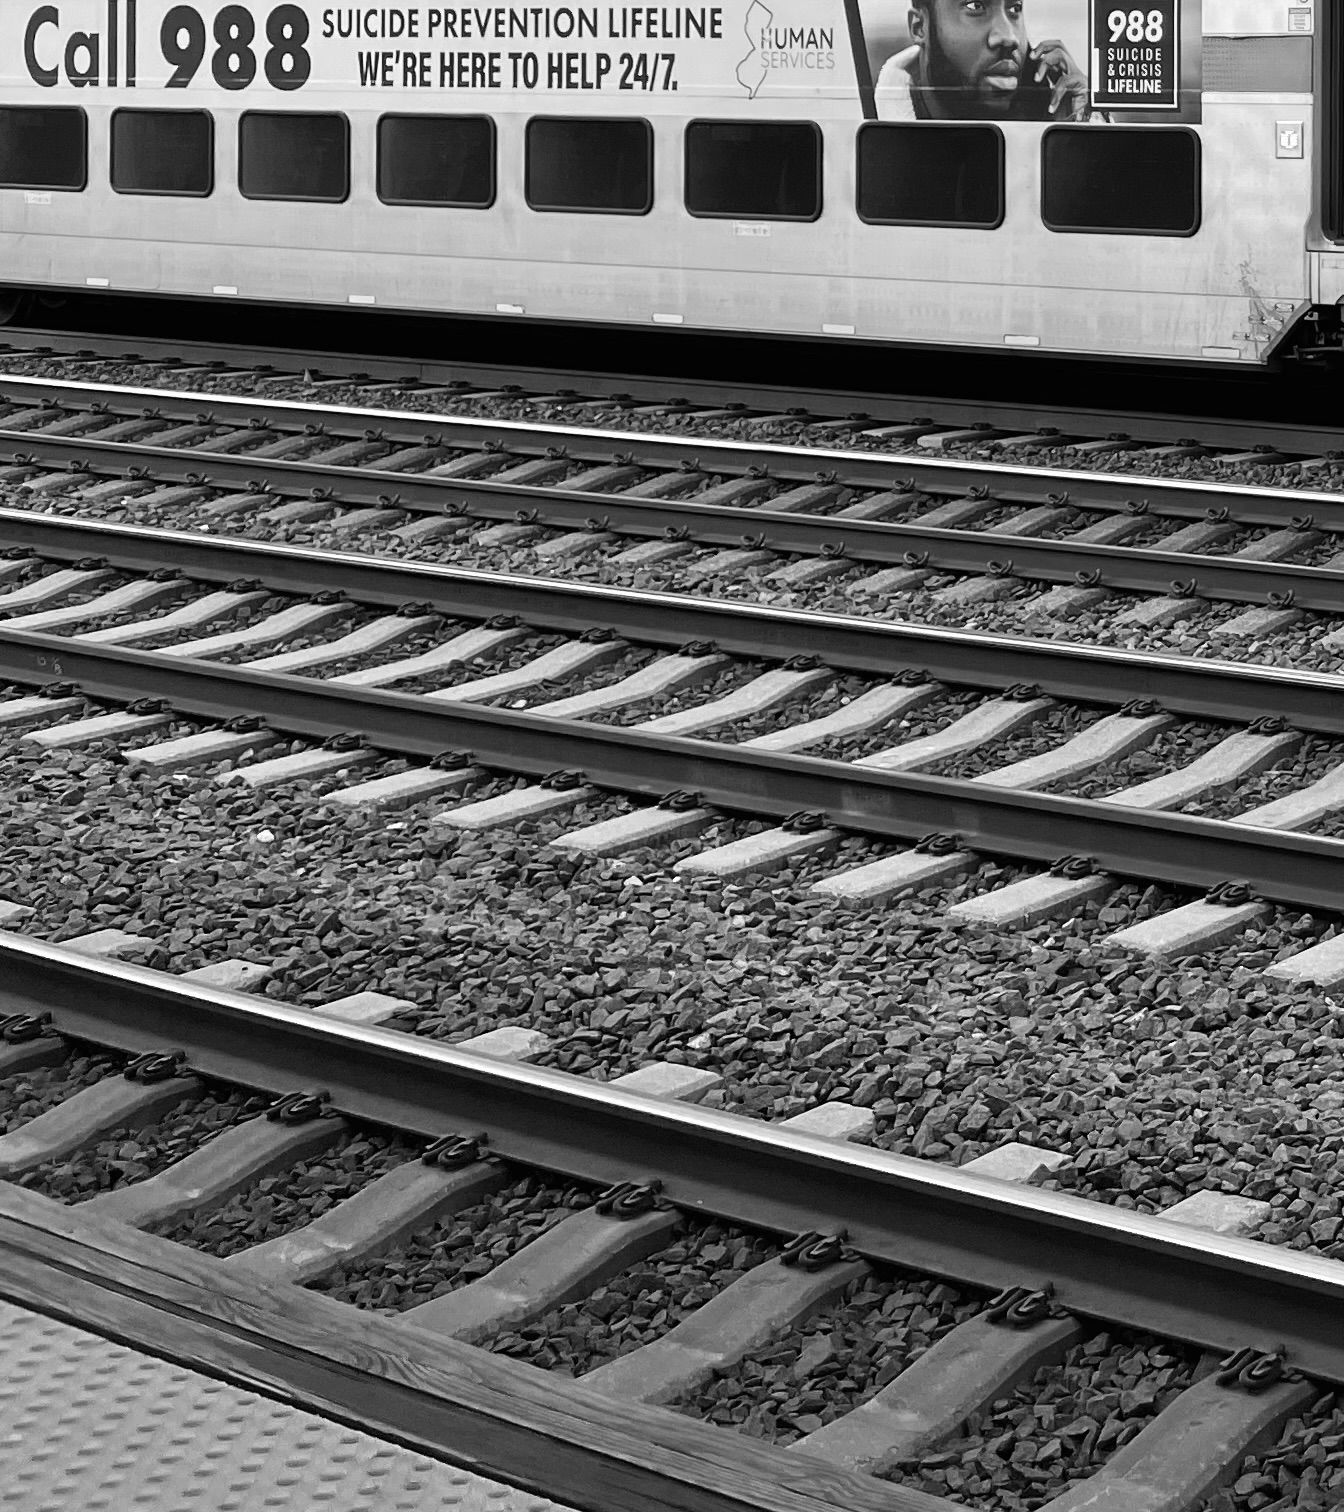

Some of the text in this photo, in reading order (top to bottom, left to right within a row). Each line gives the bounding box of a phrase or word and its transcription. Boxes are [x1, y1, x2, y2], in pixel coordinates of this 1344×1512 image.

[321, 7, 723, 39] SUICIDE PREVENTION LIFELINE
[1107, 10, 1163, 43] 988
[24, 0, 311, 91] Call 988
[760, 26, 834, 51] HUMAN
[760, 49, 835, 70] SERVICES
[1107, 48, 1162, 62] SUICIDE
[358, 49, 679, 91] WE'RE HERE TO HELP 24/7.
[1107, 80, 1162, 95] LIFELINE
